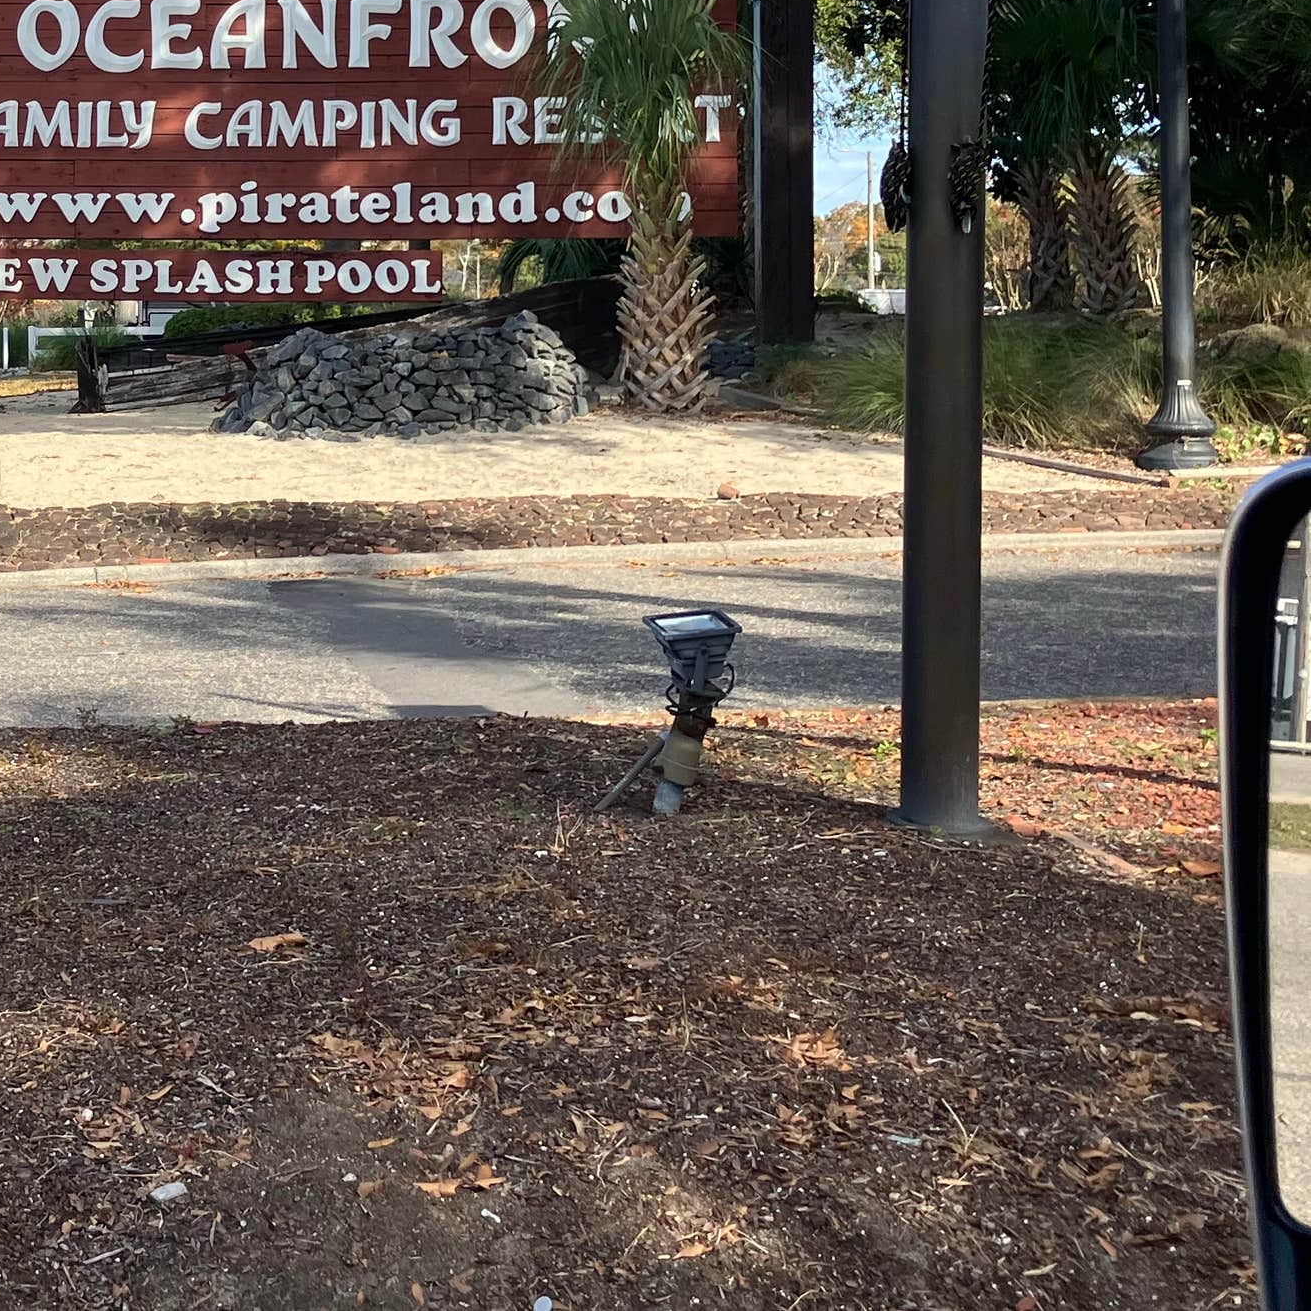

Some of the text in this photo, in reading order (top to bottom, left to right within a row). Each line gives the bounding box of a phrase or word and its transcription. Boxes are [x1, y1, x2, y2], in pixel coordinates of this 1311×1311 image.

[183, 98, 461, 150] CAMPING
[492, 94, 732, 146] RET
[89, 258, 295, 294] SPLASH
[303, 258, 443, 294] POOL
